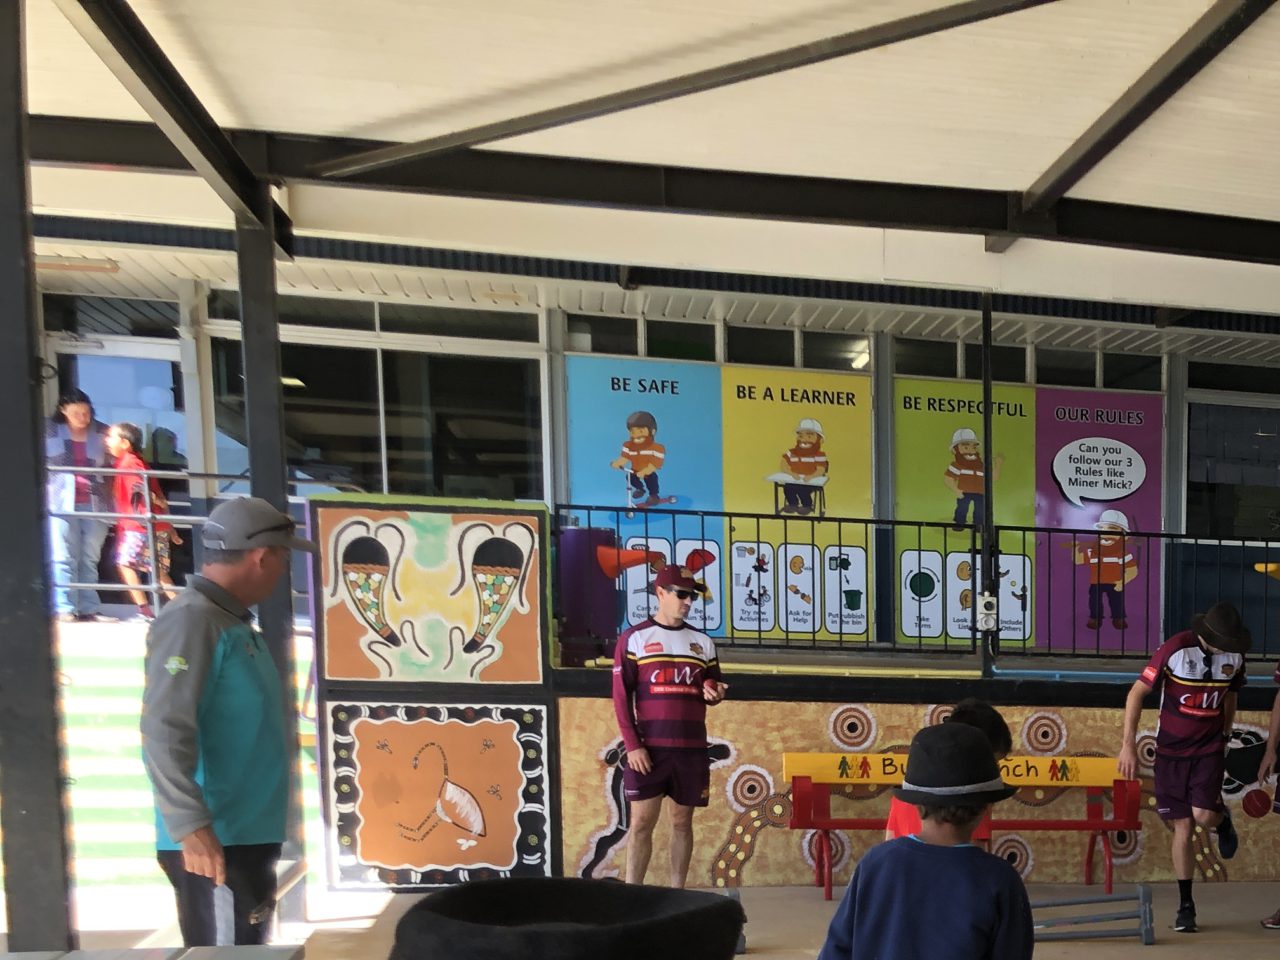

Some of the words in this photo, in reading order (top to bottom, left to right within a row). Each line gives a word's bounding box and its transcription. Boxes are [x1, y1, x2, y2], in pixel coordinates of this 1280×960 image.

[611, 377, 631, 392] BE
[637, 378, 680, 395] SAFE
[736, 385, 757, 400] BE
[763, 387, 774, 401] A
[781, 388, 856, 406] LEARNER
[903, 396, 922, 410] BE
[1055, 407, 1090, 422] OUR
[1095, 408, 1144, 425] RULES
[1078, 443, 1099, 453] Can
[1102, 446, 1122, 456] you
[1068, 454, 1102, 465] follow
[1104, 458, 1123, 466] our
[1126, 457, 1133, 467] 3
[1075, 466, 1103, 477] Rules
[1107, 468, 1125, 478] like
[1068, 477, 1100, 488] Miner
[1103, 479, 1133, 490] Mick?
